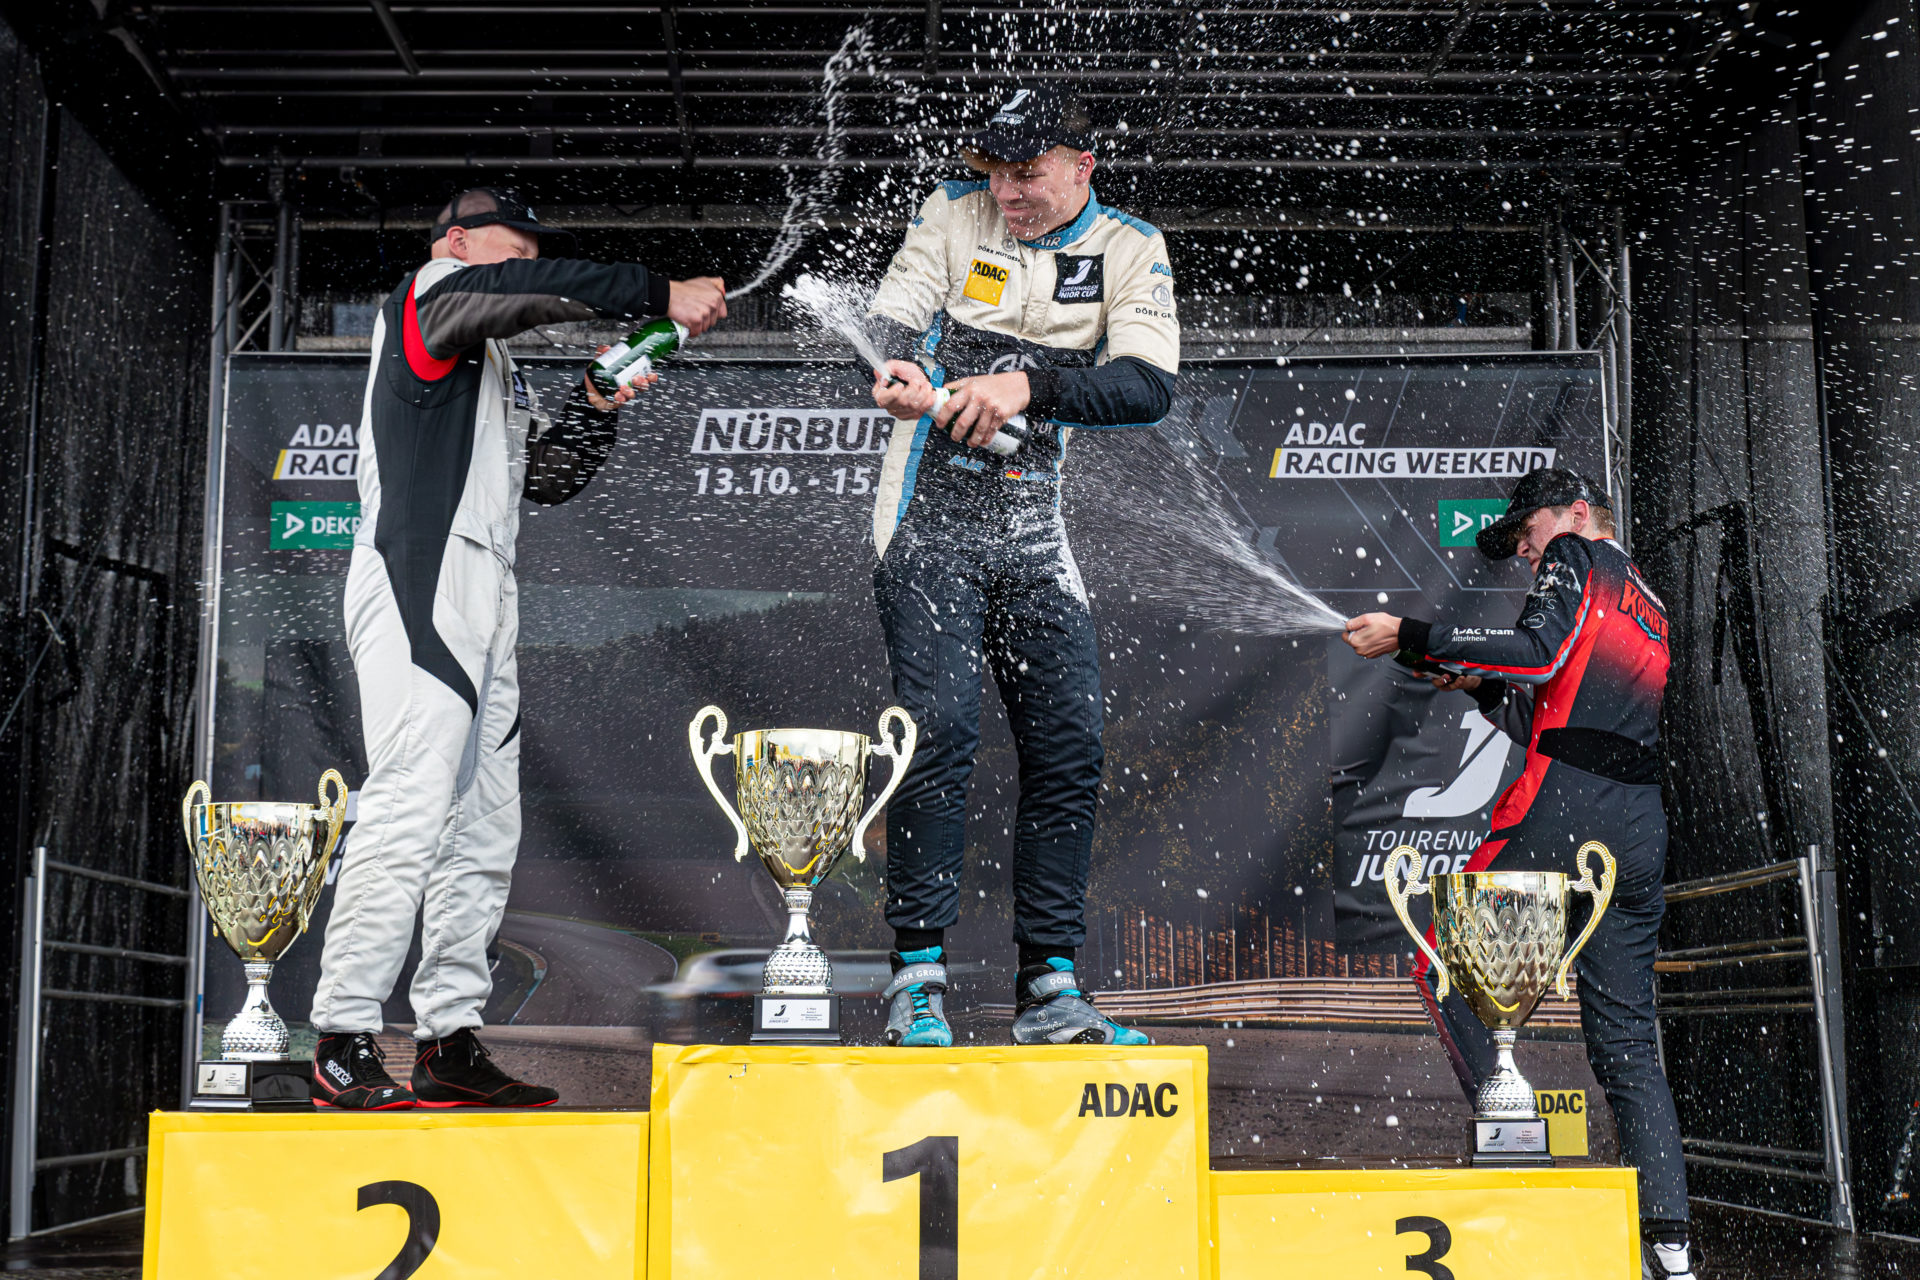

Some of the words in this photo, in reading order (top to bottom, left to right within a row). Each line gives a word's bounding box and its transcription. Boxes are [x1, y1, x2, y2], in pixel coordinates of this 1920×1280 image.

[974, 261, 1007, 282] ADAC
[1135, 308, 1159, 317] DÖRR
[289, 424, 361, 447] ADA
[702, 412, 896, 451] NÜRBUR
[1284, 423, 1366, 446] ADAC
[1285, 452, 1396, 475] RACING
[1406, 450, 1547, 475] WEEKEND
[694, 467, 799, 495] 13.10.
[1484, 628, 1514, 636] Team
[326, 1059, 353, 1084] sparco
[1078, 1083, 1179, 1118] ADAC
[1537, 1092, 1583, 1115] DAC
[882, 1136, 958, 1280] 1
[357, 1180, 440, 1280] 2
[1395, 1215, 1456, 1280] 3
